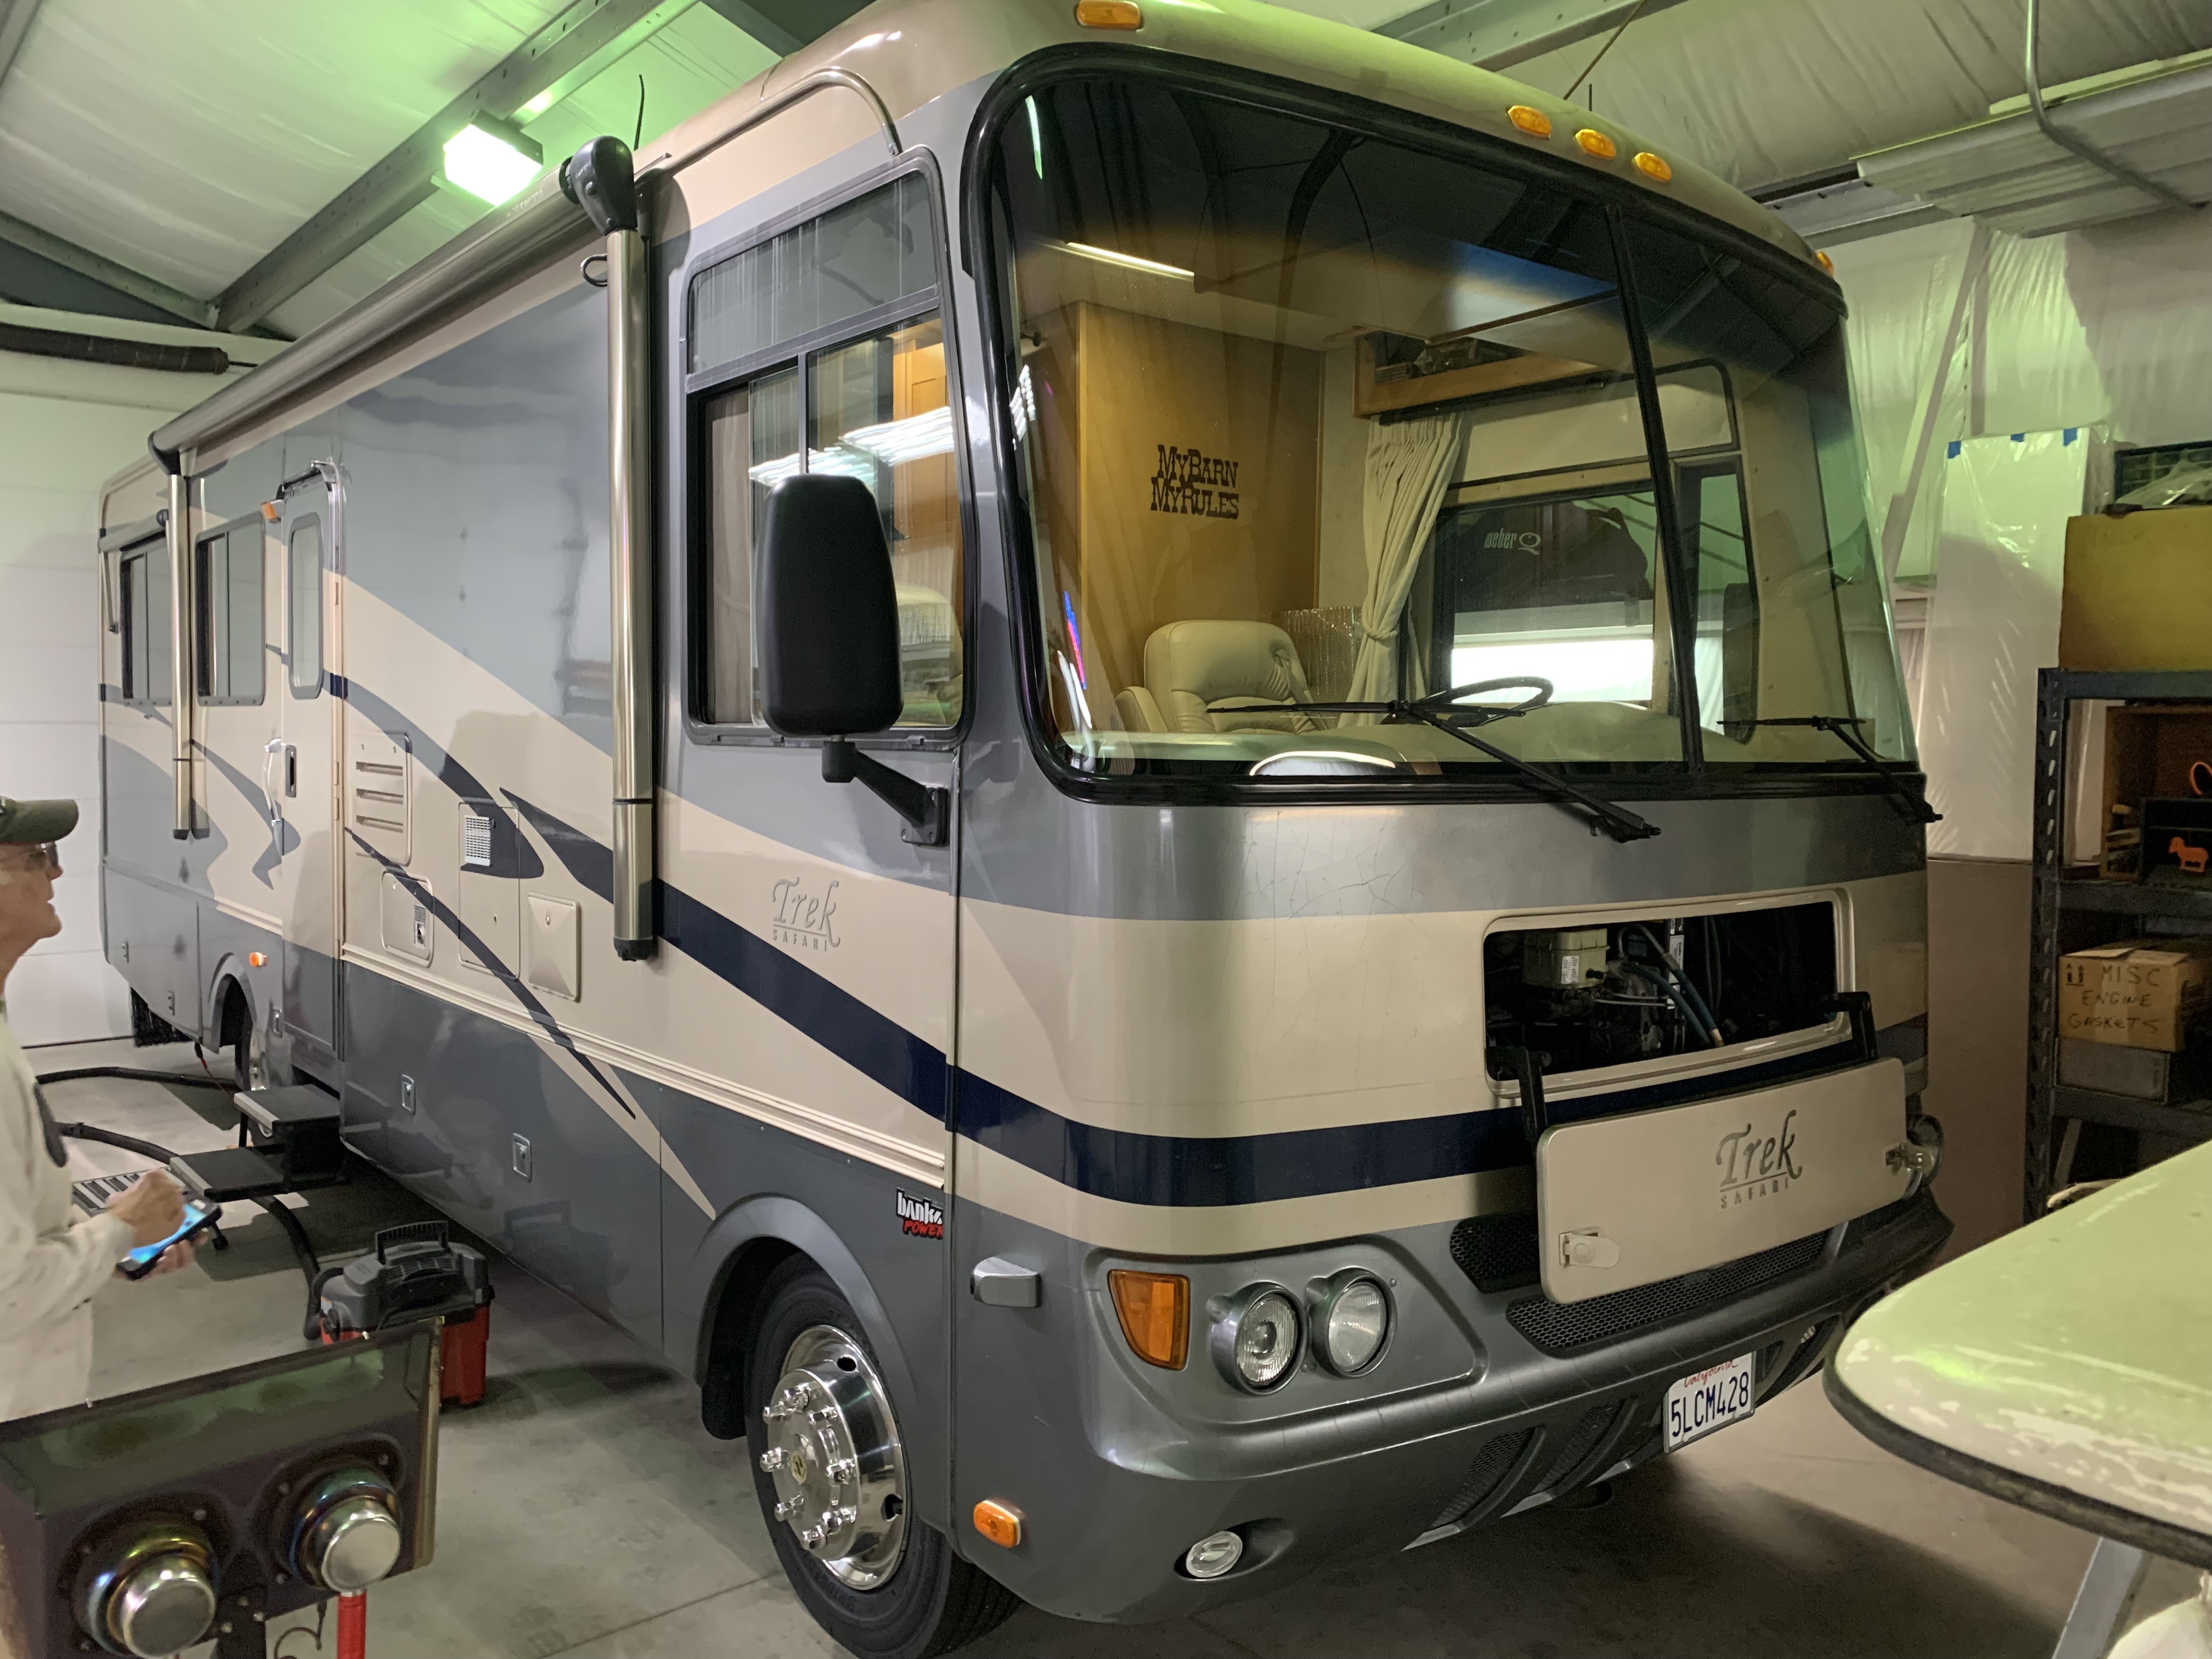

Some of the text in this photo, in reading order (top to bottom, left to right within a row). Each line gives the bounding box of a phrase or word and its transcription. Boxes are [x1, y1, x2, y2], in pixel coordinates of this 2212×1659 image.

[1484, 528, 1541, 555] weber Q
[772, 876, 840, 947] Trek
[772, 929, 827, 952] SAFARI
[2102, 963, 2160, 987] MISC
[2081, 990, 2151, 1007] ENGINE
[1716, 1109, 1803, 1180] Trek
[1720, 1176, 1788, 1209] SAFARI
[1671, 1371, 1749, 1437] 5LCM428
